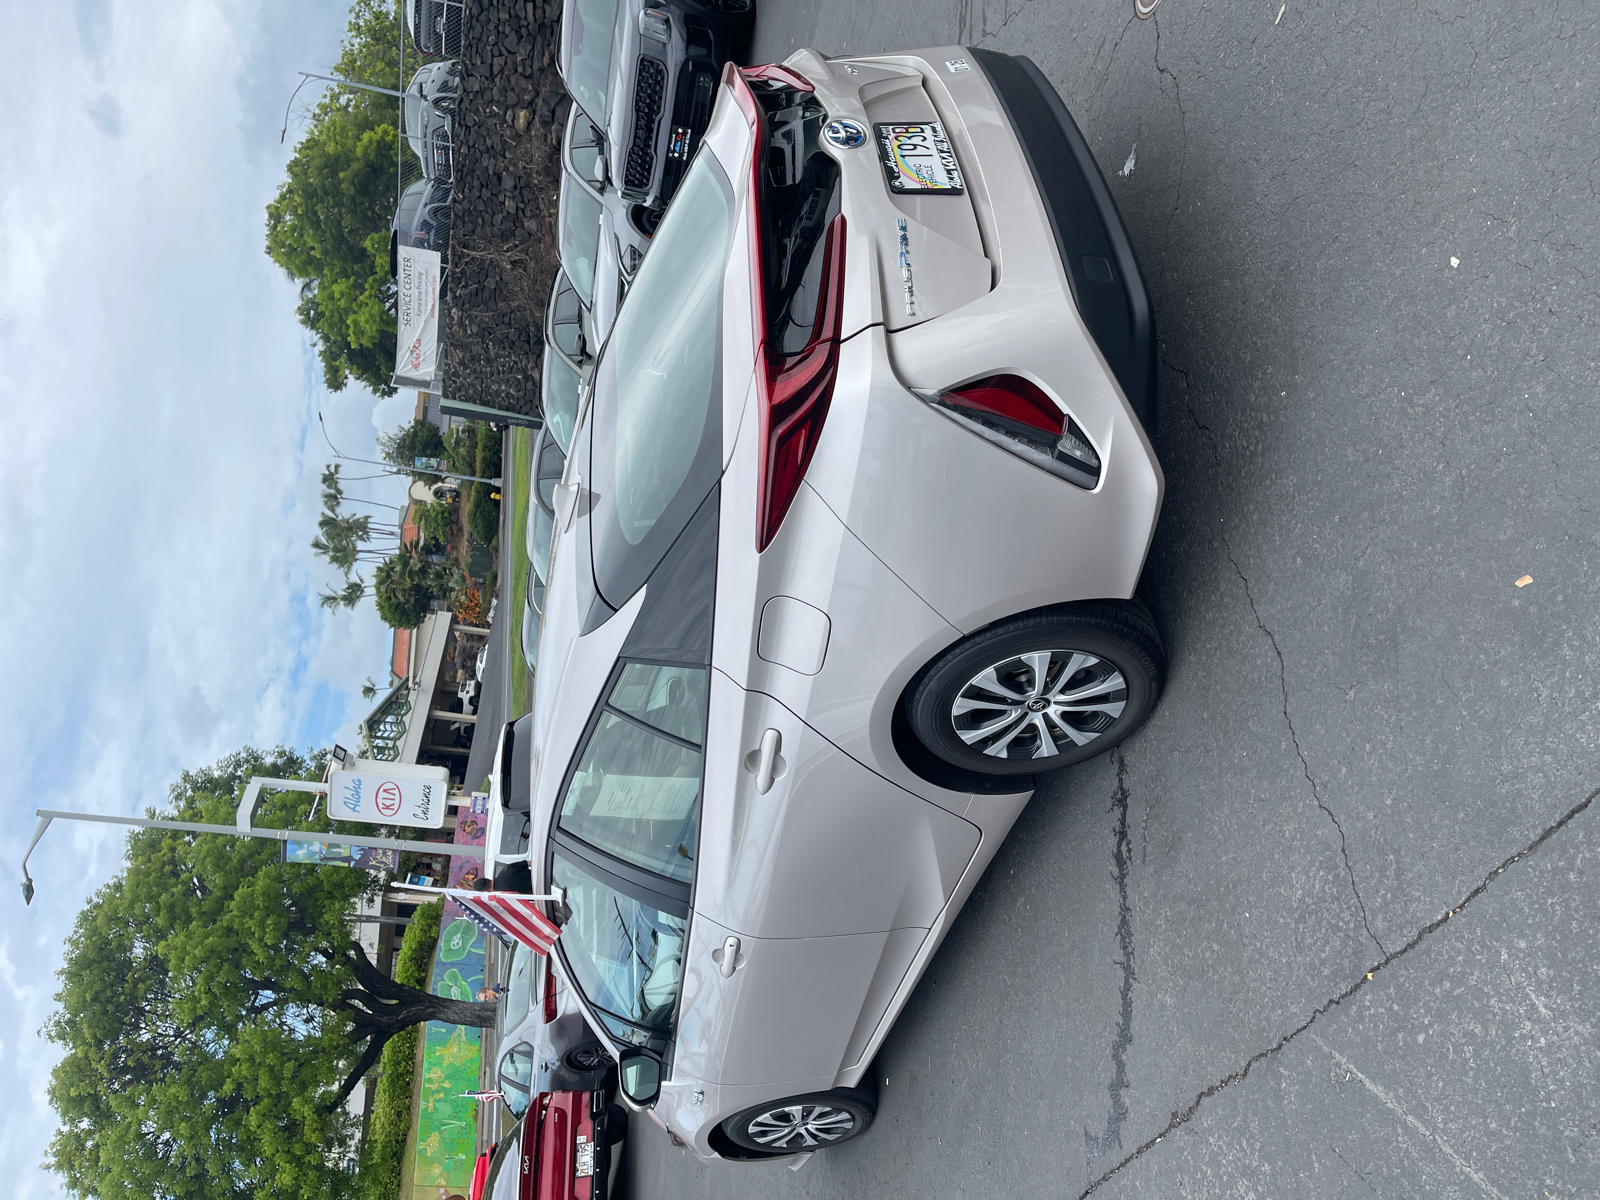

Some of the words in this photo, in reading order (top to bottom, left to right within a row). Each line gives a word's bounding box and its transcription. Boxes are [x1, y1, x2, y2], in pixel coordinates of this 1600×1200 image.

[891, 126, 933, 159] 193B
[928, 122, 947, 141] Islands
[882, 139, 898, 172] Hawaii
[914, 164, 928, 188] ELECTRIC
[924, 165, 938, 187] VEHICLE
[947, 170, 963, 188] Aloha
[896, 218, 911, 268] PRIME
[403, 257, 412, 290] CENTER
[416, 271, 424, 290] Pricing
[902, 268, 916, 316] PRIUS
[403, 293, 412, 327] SERVICE
[343, 778, 361, 813] Aloha
[382, 788, 396, 810] KIA
[413, 785, 432, 820] Entrance
[580, 1144, 590, 1157] 195
